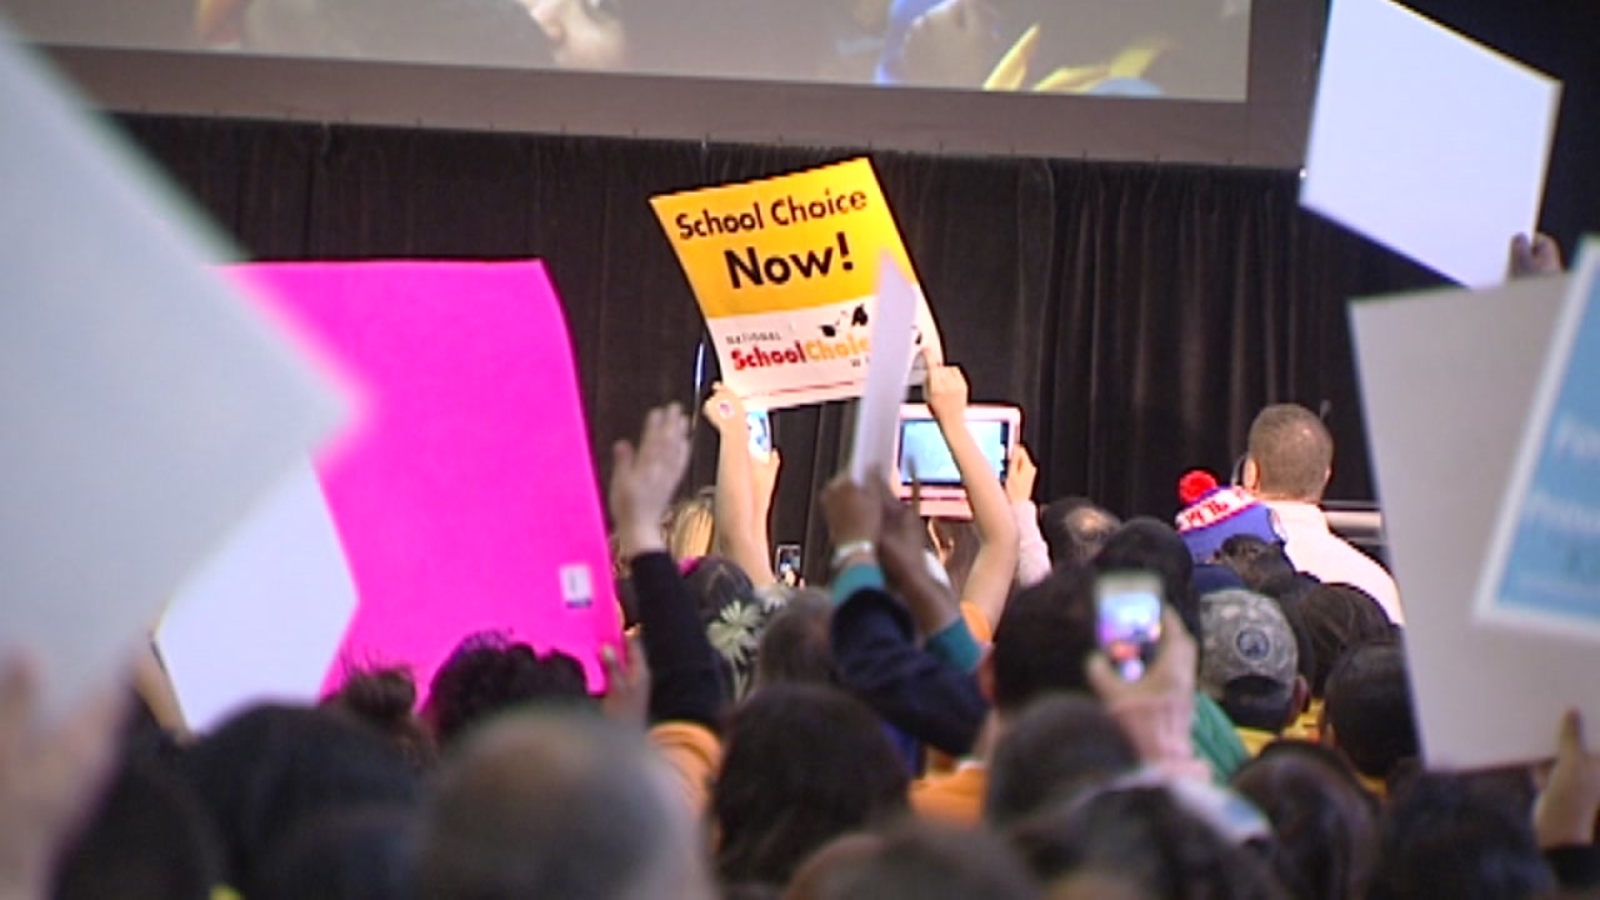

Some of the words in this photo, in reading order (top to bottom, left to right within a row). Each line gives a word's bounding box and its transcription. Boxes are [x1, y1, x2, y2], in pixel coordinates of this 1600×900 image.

[676, 202, 764, 240] School
[771, 188, 868, 227] Choice
[724, 232, 854, 290] Now!
